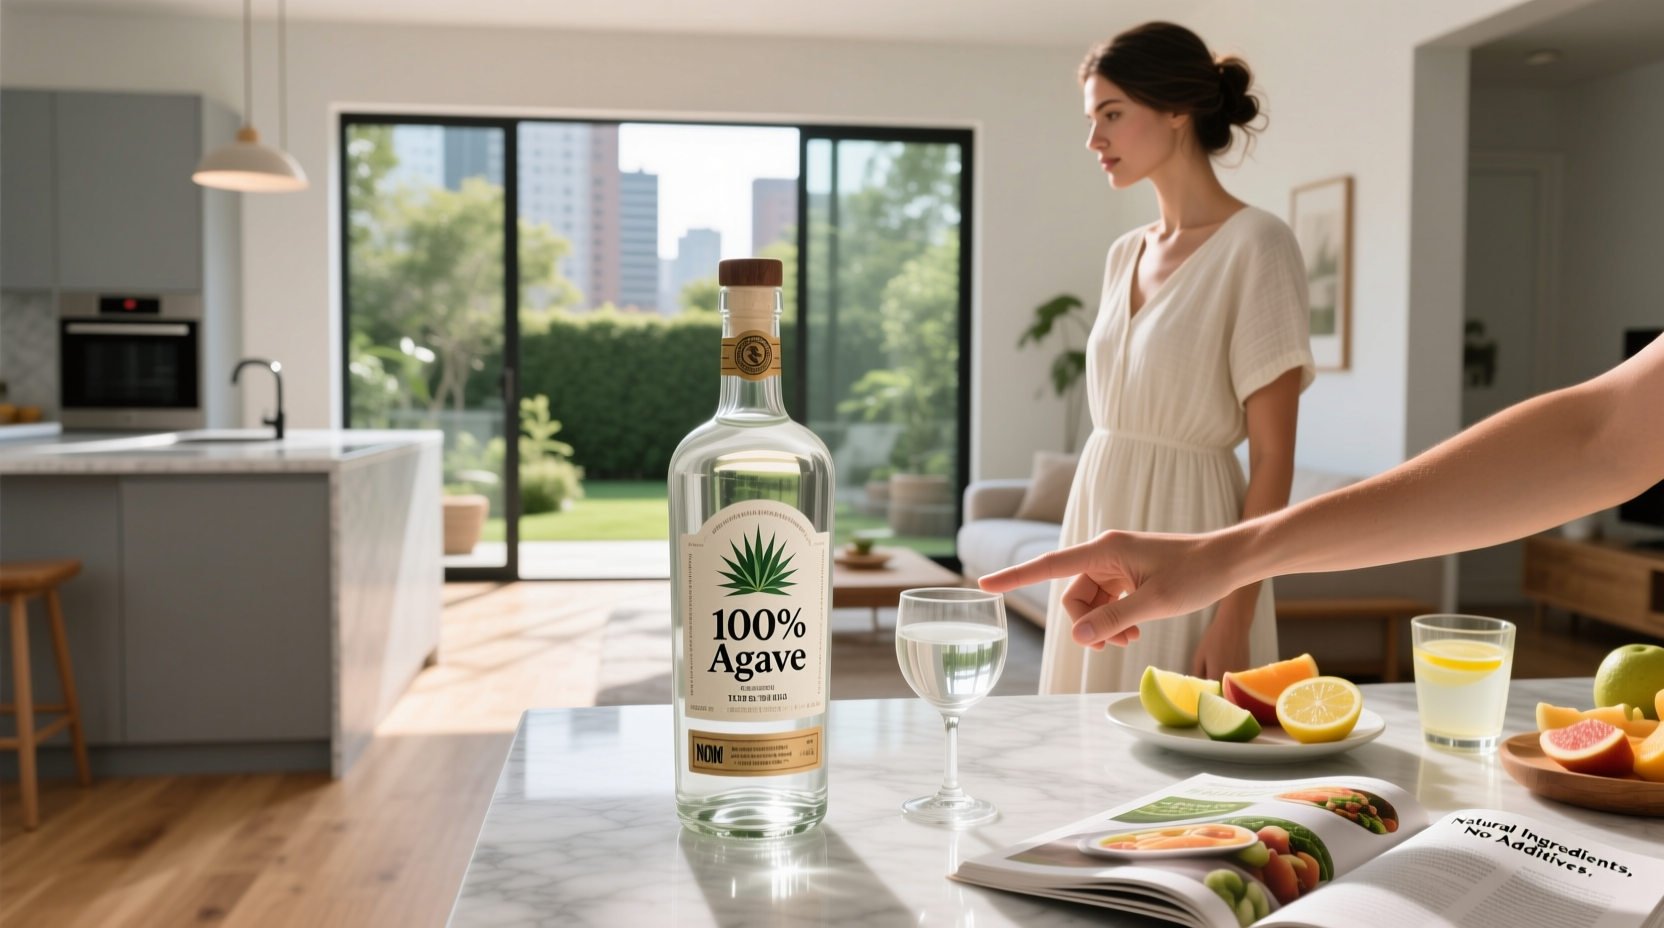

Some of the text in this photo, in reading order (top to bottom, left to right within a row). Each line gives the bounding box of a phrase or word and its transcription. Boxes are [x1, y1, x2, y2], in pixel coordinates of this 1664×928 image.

[712, 607, 806, 641] 100%
[707, 643, 806, 683] Agave
[1451, 817, 1633, 877] Natural Ingredients,
[1464, 826, 1492, 839] No
